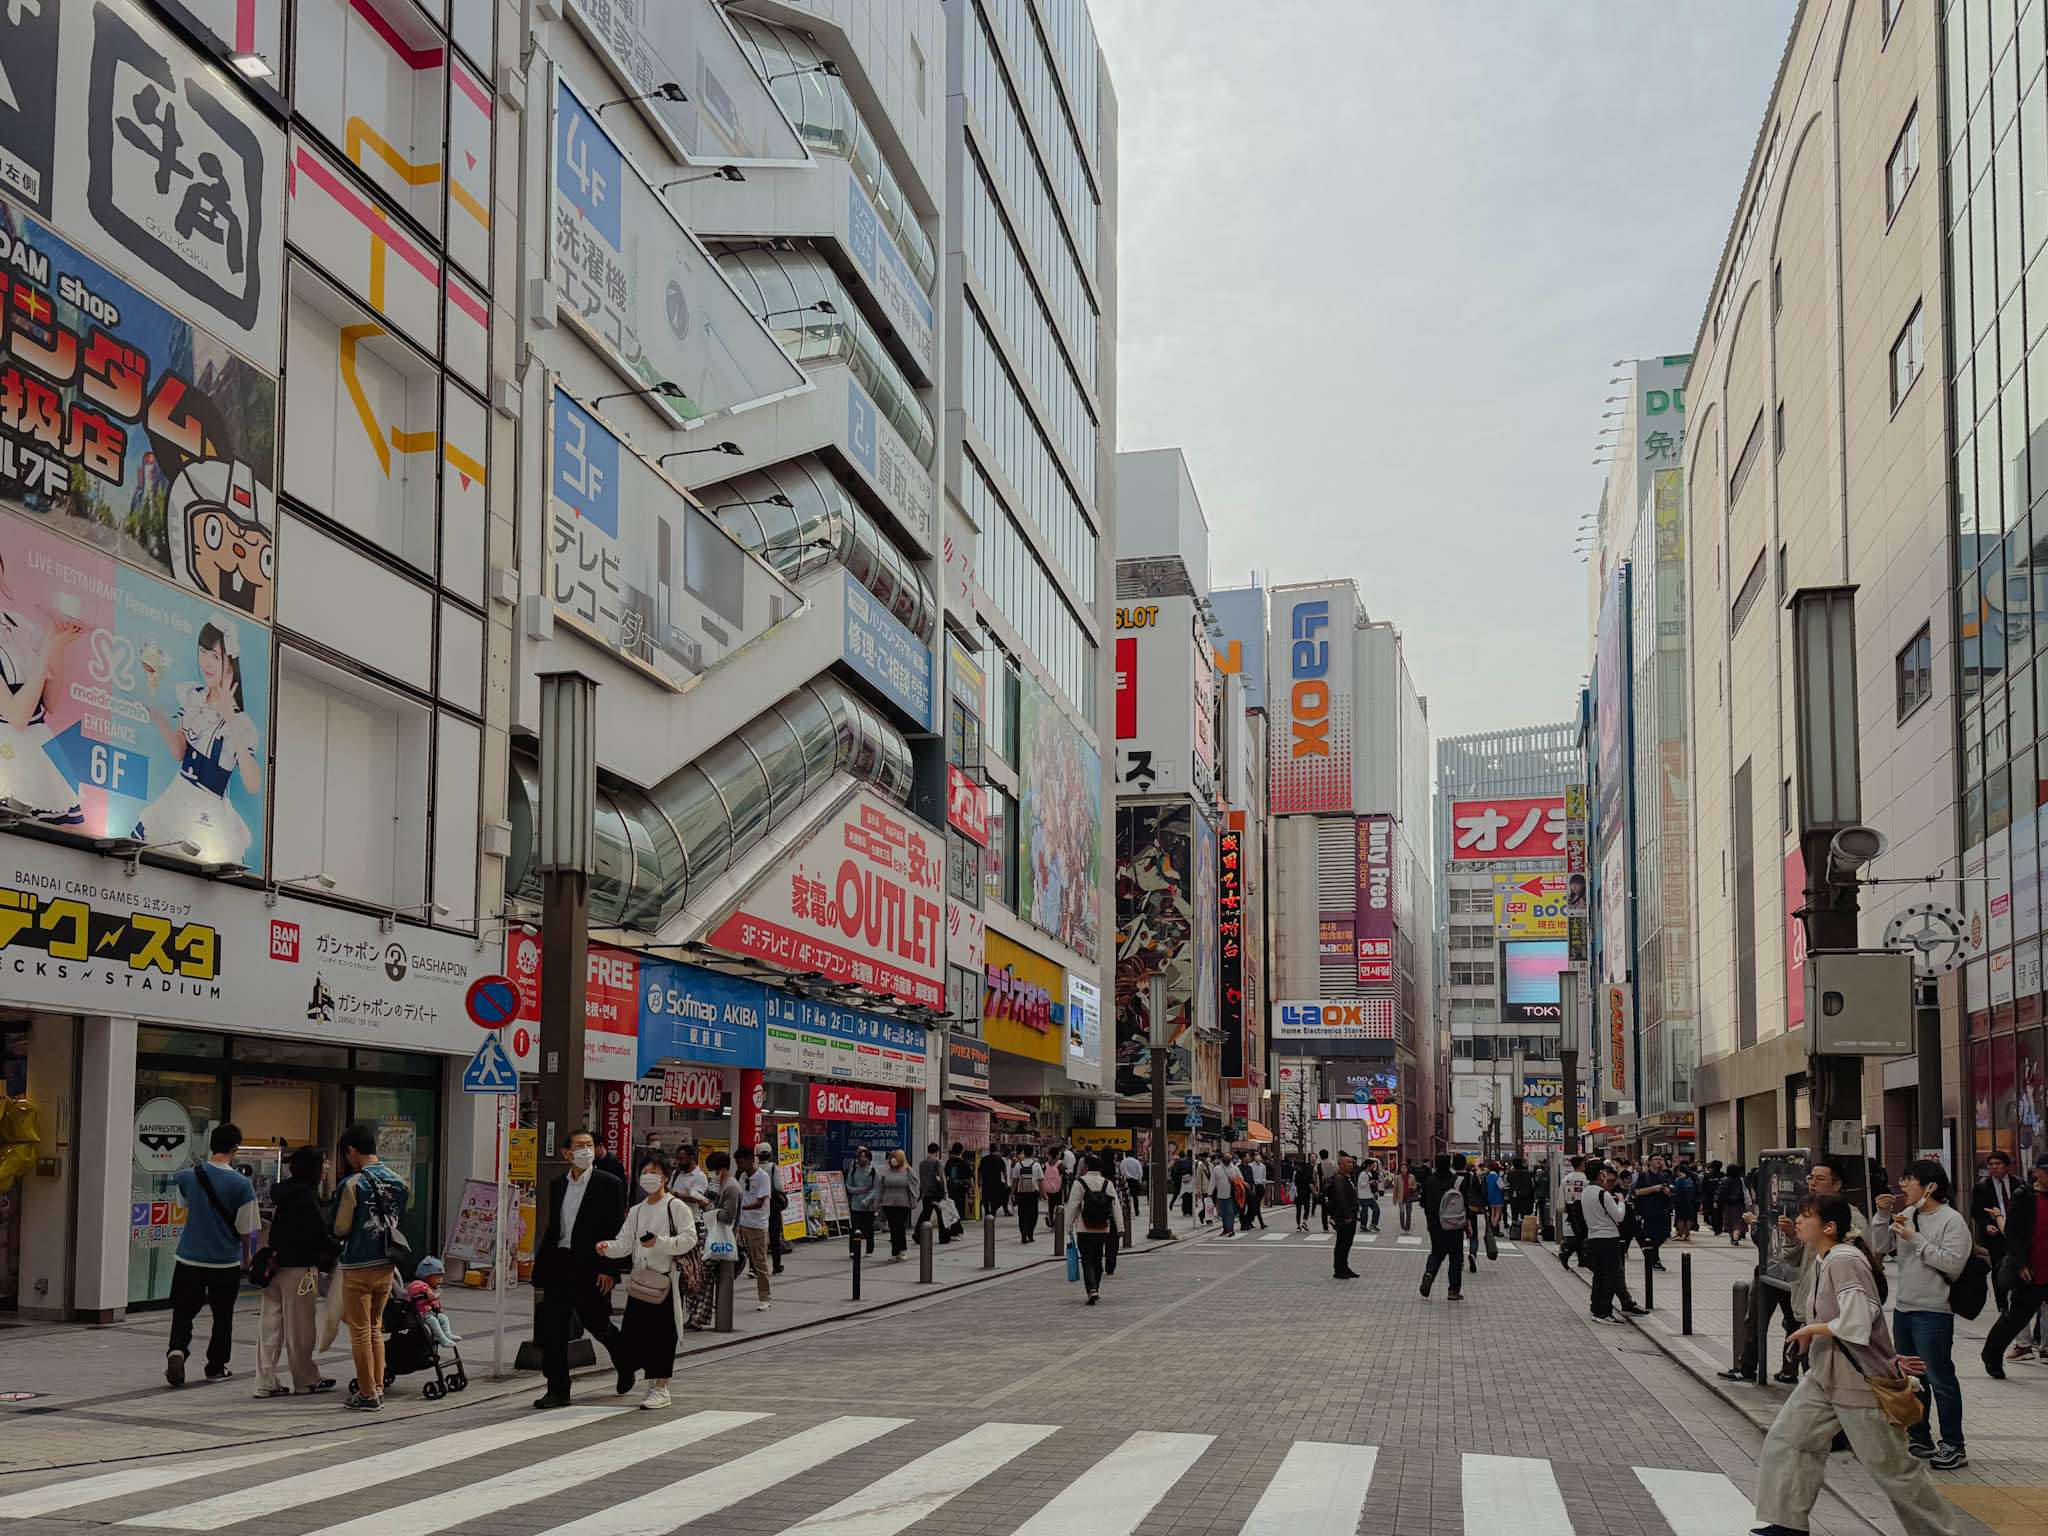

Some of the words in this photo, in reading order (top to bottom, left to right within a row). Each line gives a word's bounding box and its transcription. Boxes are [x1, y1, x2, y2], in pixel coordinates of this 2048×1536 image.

[0, 158, 37, 196] 左側
[115, 84, 243, 274] 牛角
[566, 112, 606, 208] 4F
[557, 206, 627, 312] 洗濯機
[60, 275, 119, 326] shop
[558, 258, 641, 365] エアコン
[0, 272, 202, 457] ンダム
[562, 411, 603, 502] 3F
[555, 514, 620, 594] テレビ
[28, 551, 53, 576] LIVE
[56, 564, 124, 606] RESTAURANT
[1116, 606, 1158, 629] SLOT
[84, 715, 137, 745] ENTRANCE
[90, 744, 127, 789] 6F
[1369, 821, 1390, 865] Duty
[15, 871, 61, 890] BANDAI
[66, 882, 97, 897] CARD
[101, 888, 139, 906] GAMES
[143, 897, 191, 916] 公式ショップ
[1359, 863, 1368, 889] Store
[1369, 868, 1390, 909] Free
[791, 864, 837, 929] 家電の
[836, 858, 940, 969] OUTLET
[272, 939, 293, 958] DAI
[273, 924, 298, 944] BAN
[317, 933, 380, 962] ガシャポン
[0, 957, 67, 979] CKS
[105, 972, 220, 999] STADIUM
[411, 955, 467, 979] GASHAPON
[587, 953, 633, 992] FREE
[338, 993, 437, 1024] ガシャポンのデパート
[666, 990, 717, 1027] Sofmap
[722, 1003, 758, 1029] AKIBA
[802, 1004, 811, 1025] 1F
[831, 1012, 840, 1031] 2F
[857, 1018, 867, 1035] 3F
[883, 1024, 891, 1041] 4F
[906, 1030, 915, 1046] 5F
[829, 1093, 874, 1116] BicCamera
[139, 1124, 187, 1134] BANPRESTORE
[131, 1226, 147, 1240] RE
